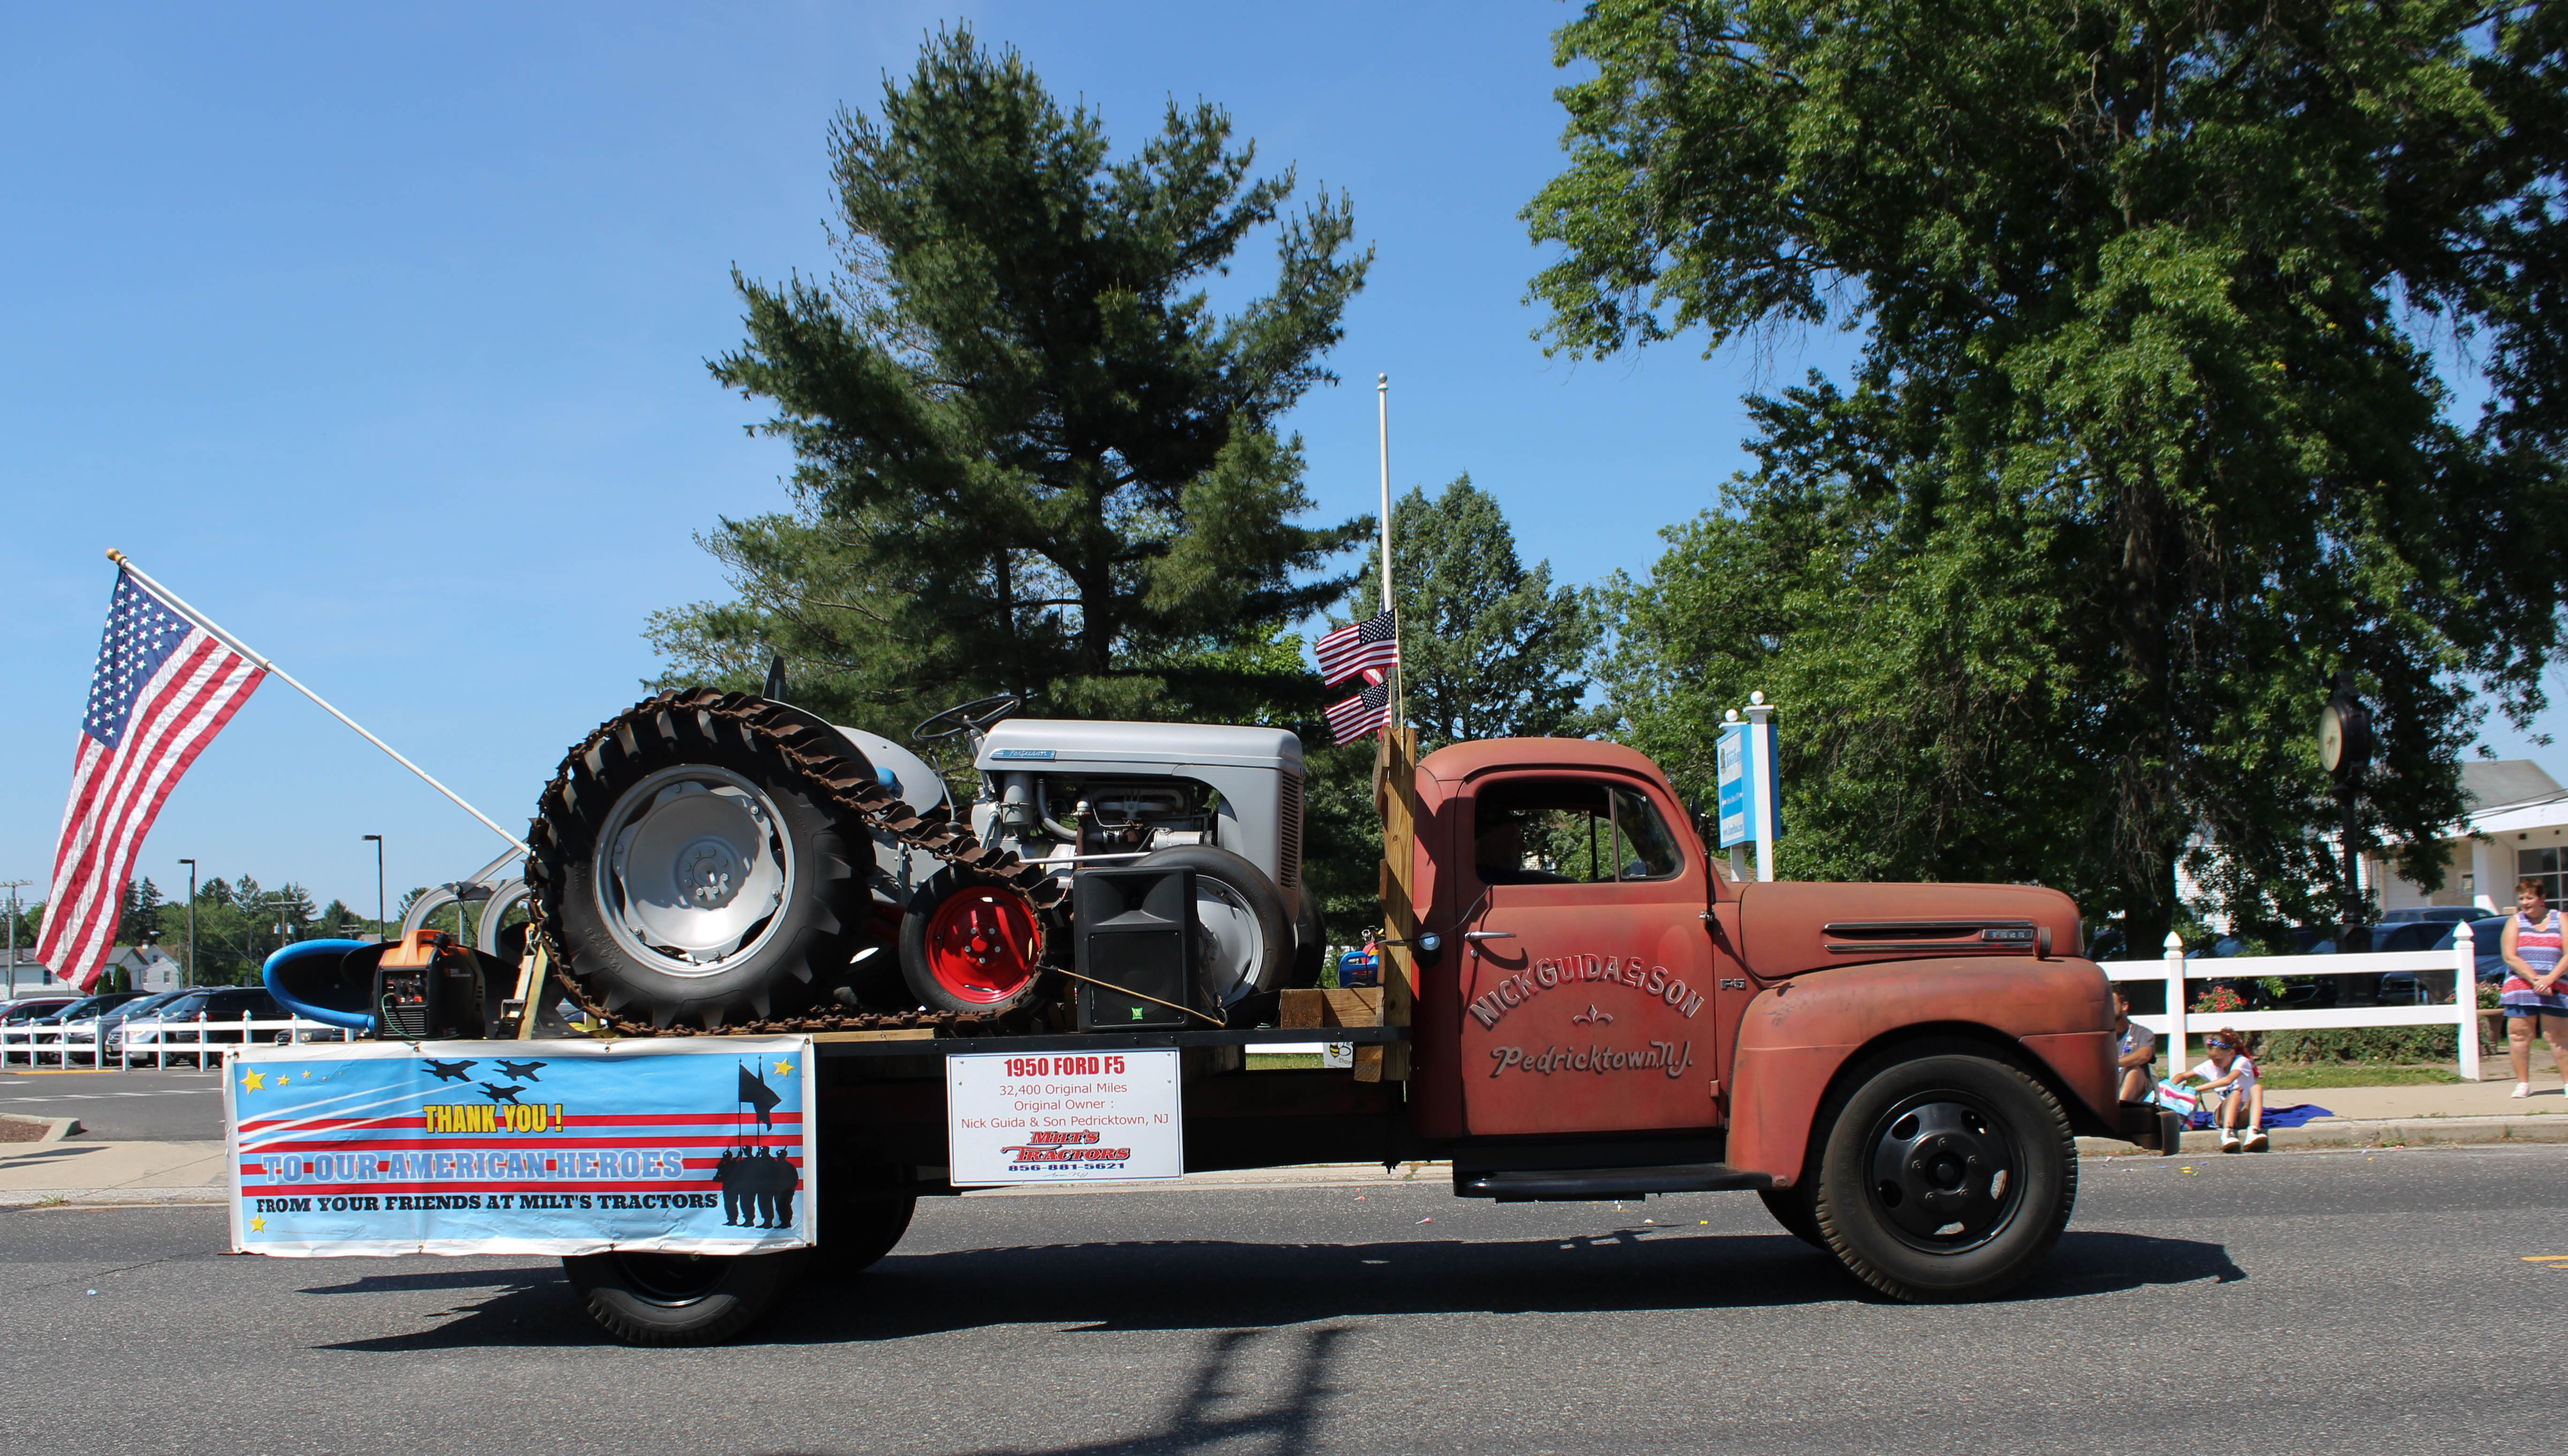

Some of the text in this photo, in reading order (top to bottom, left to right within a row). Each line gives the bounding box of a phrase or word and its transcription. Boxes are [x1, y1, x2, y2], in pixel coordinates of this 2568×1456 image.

[1720, 978, 1745, 988] F-5
[1469, 967, 1540, 1030] NICK
[1534, 953, 1621, 990] GUIDA
[1644, 966, 1704, 1019] SON
[1004, 1056, 1125, 1077] 1950 FORD F5
[1000, 1083, 1127, 1097] 32,400 Original Miles
[1014, 1099, 1061, 1112] Original
[1065, 1099, 1106, 1109] Owner
[424, 1105, 497, 1133] THANK
[502, 1104, 547, 1132] YOU
[962, 1113, 1168, 1129] Nick Guida & Son Pedricktown, NJ
[1028, 1129, 1100, 1145] MILT'S
[1000, 1145, 1131, 1162] TRACTORS
[262, 1150, 684, 1183] TO OUR AMERICAN HEROES
[1008, 1162, 1125, 1171] 856-881-5621
[257, 1193, 718, 1213] FROM YOUR FRIENDS AT MILT'S TRACTORS
